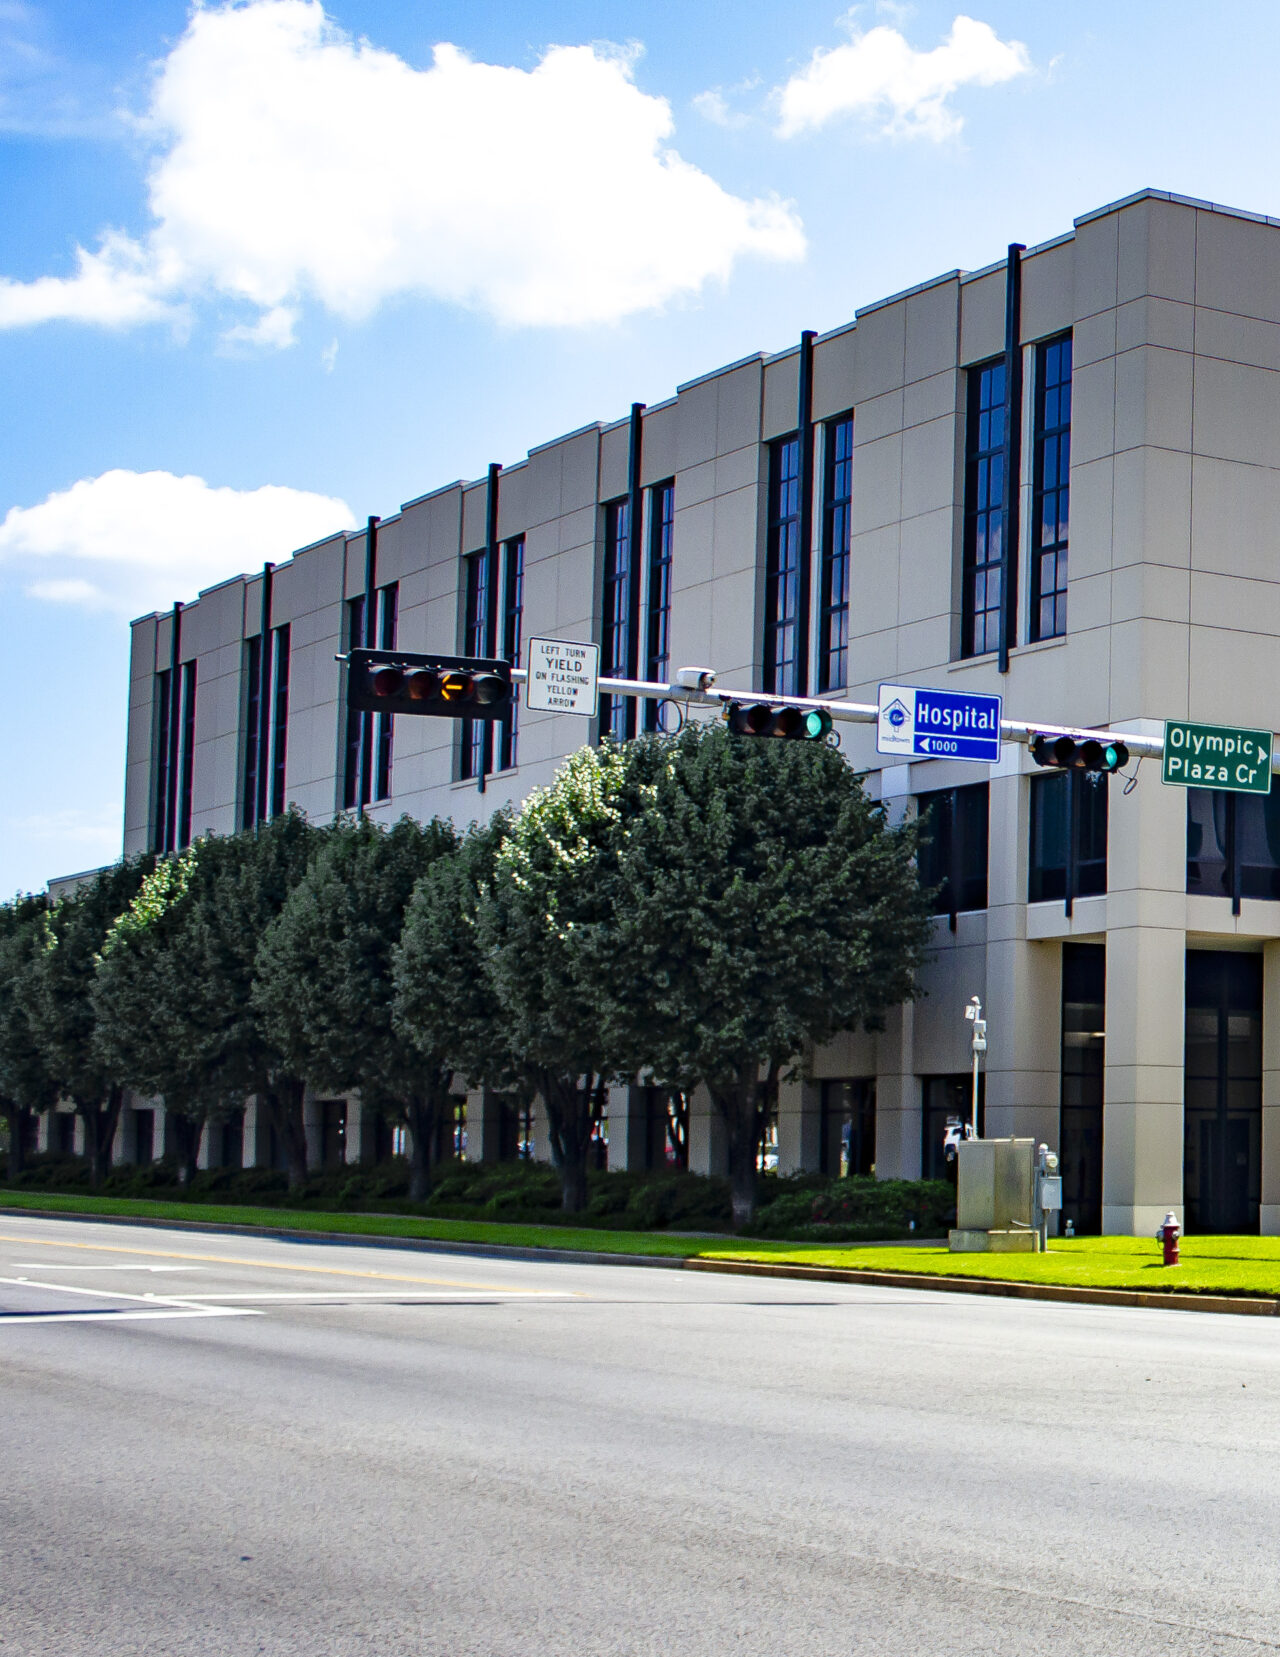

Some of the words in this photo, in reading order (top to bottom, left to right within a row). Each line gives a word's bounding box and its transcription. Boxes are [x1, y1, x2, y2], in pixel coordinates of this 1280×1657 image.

[541, 645, 560, 656] LEFT
[565, 648, 586, 659] TURN
[545, 657, 582, 672] YIELD
[535, 671, 547, 680] ON
[551, 672, 589, 686] FLASHING
[546, 684, 578, 696] YELLOW
[548, 697, 576, 708] ARROW
[918, 703, 995, 732] Hospital
[931, 740, 958, 752] 1000
[1170, 728, 1254, 757] Olympic
[1168, 756, 1228, 782] Plaza
[1235, 764, 1257, 784] Cr
